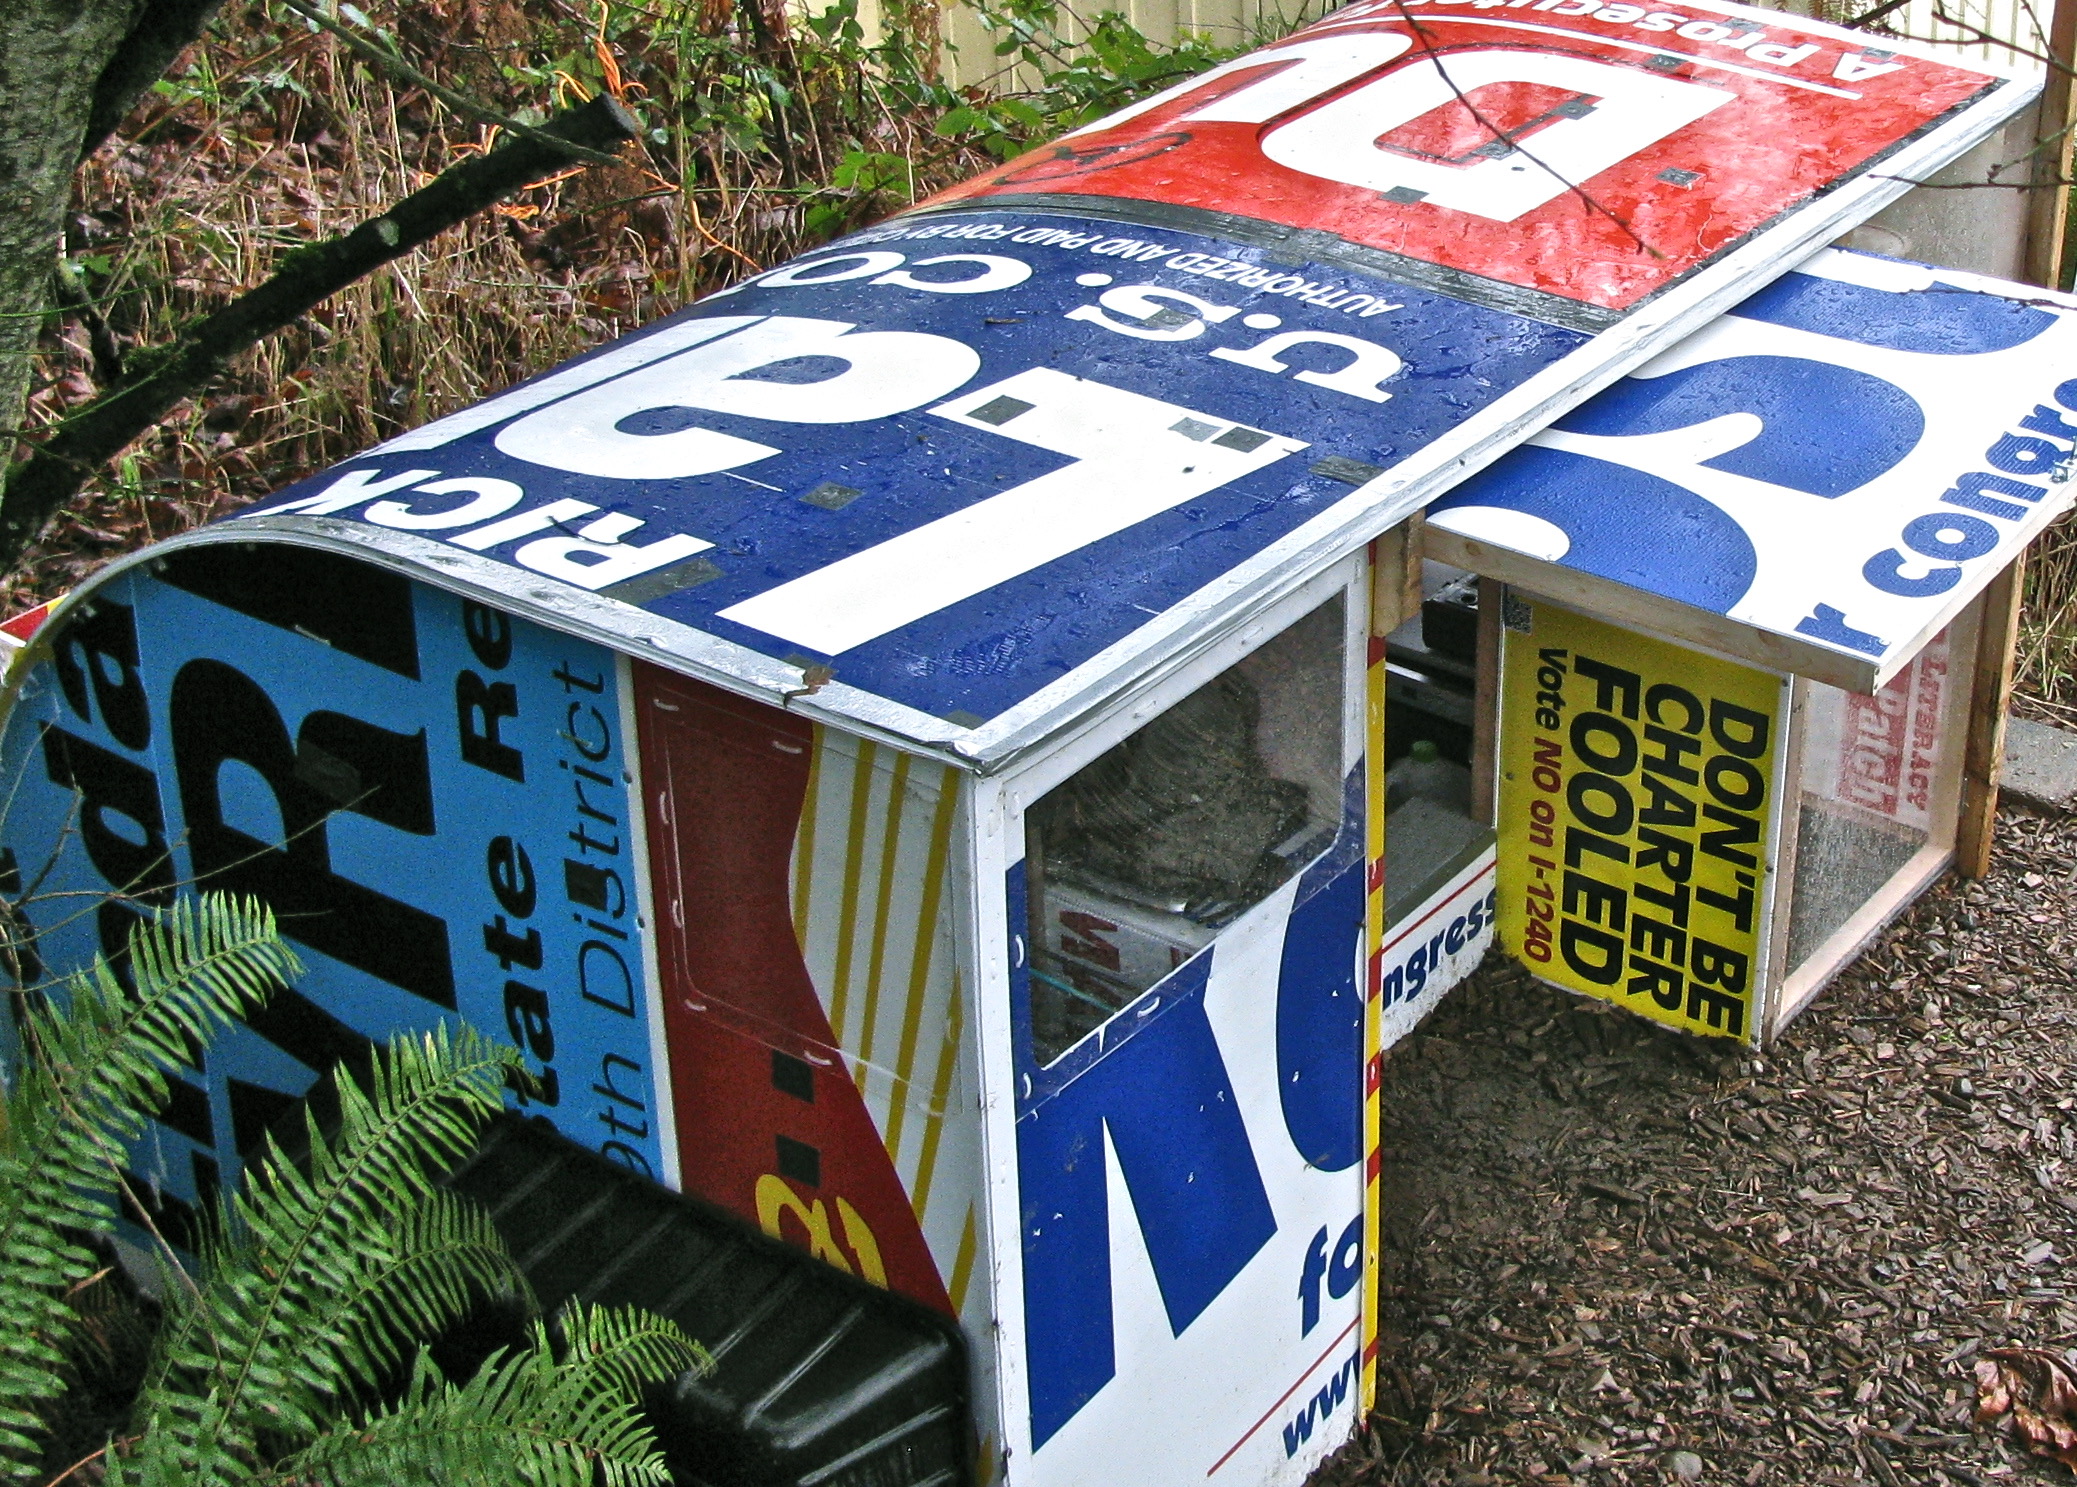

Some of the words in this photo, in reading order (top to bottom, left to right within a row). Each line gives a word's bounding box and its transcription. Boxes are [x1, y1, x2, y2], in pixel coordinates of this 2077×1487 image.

[1831, 51, 1907, 83] A
[954, 223, 1018, 242] FOR
[1013, 226, 1098, 252] PAID
[1095, 238, 1165, 264] AND
[1165, 252, 1404, 318] AUTHORIZED
[1064, 272, 1404, 403] U.S.
[237, 467, 717, 592] RICK
[1862, 377, 2077, 599] congr
[1534, 648, 1569, 732] Vote
[1530, 736, 1563, 794] NO
[1529, 799, 1556, 848] on
[1560, 654, 1642, 987] FOOLED
[1626, 683, 1705, 1012] CHARTER
[1696, 698, 1770, 935] DON'T
[1523, 854, 1557, 964] I-1240
[483, 834, 560, 1130] tate
[1686, 936, 1749, 1038] BE
